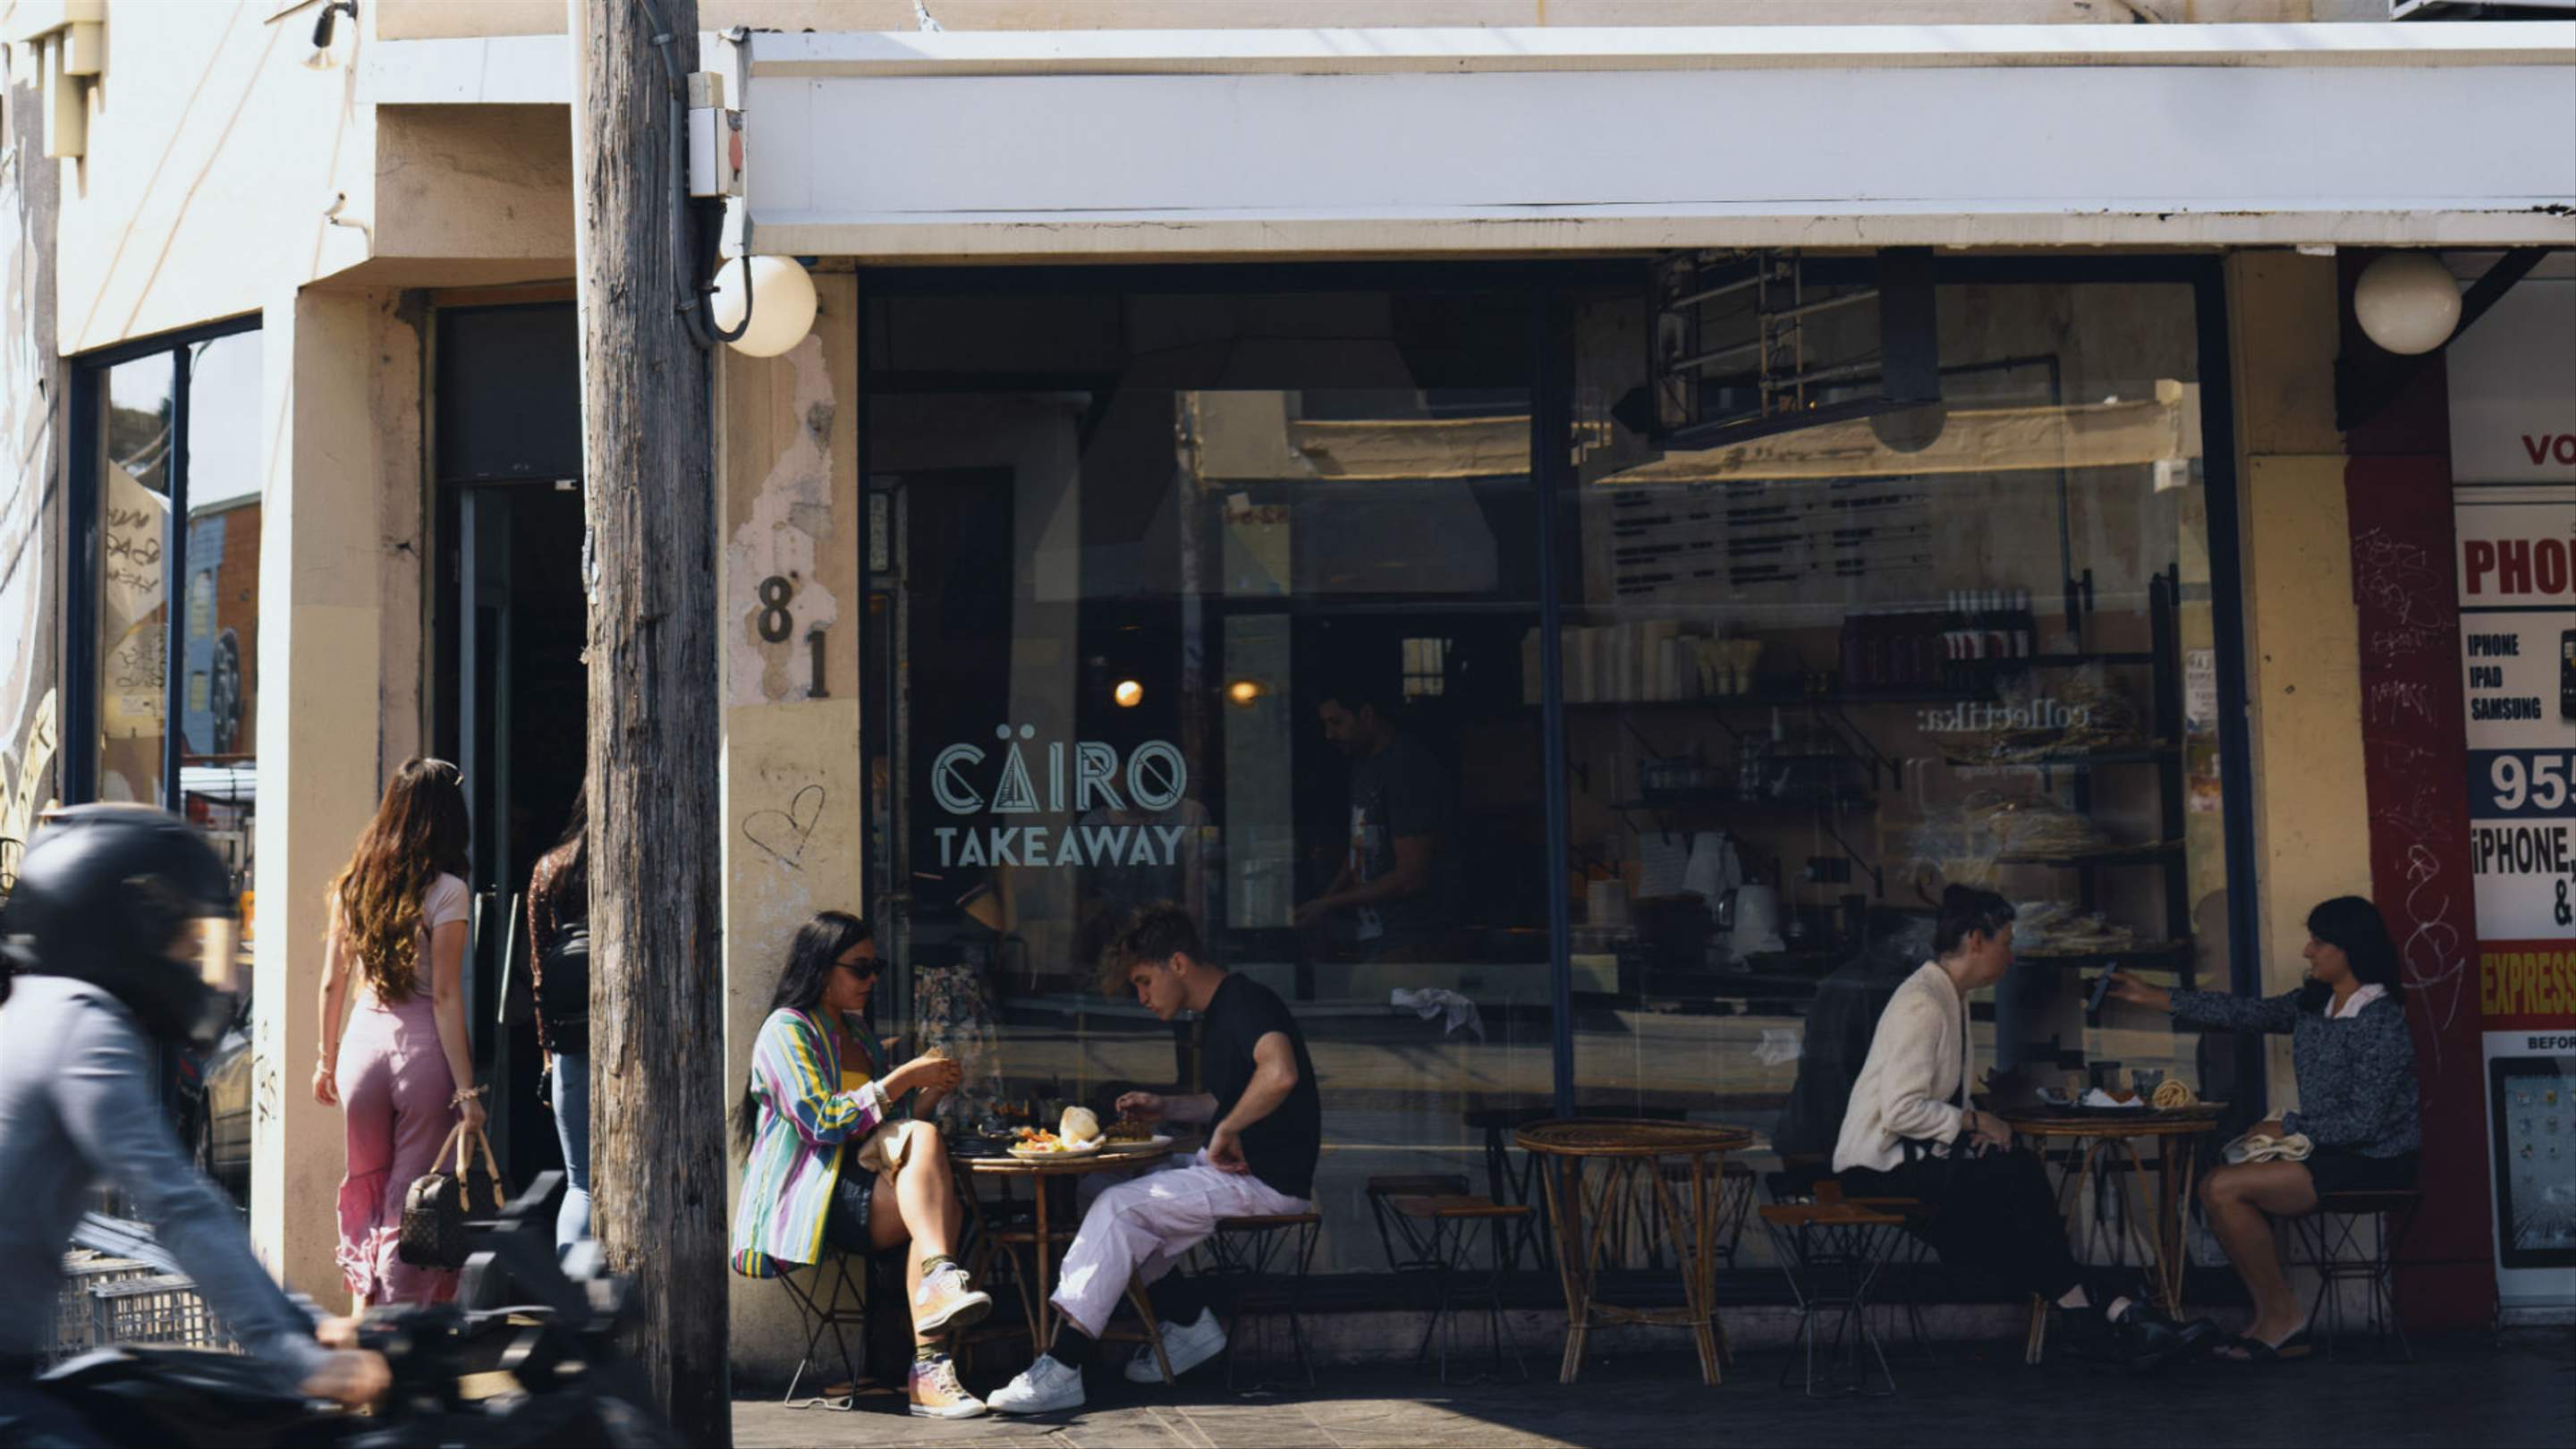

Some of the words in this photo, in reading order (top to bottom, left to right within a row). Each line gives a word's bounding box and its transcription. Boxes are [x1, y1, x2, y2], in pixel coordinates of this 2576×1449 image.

[2521, 433, 2576, 466] VO
[2464, 538, 2576, 595] PHO
[2467, 633, 2520, 657] IPHONE
[2470, 665, 2502, 688] IPAD
[2471, 697, 2541, 720] SAMSUNG
[2489, 754, 2576, 811] 95
[934, 825, 1186, 868] TAKEAWAY
[2555, 879, 2572, 926] &
